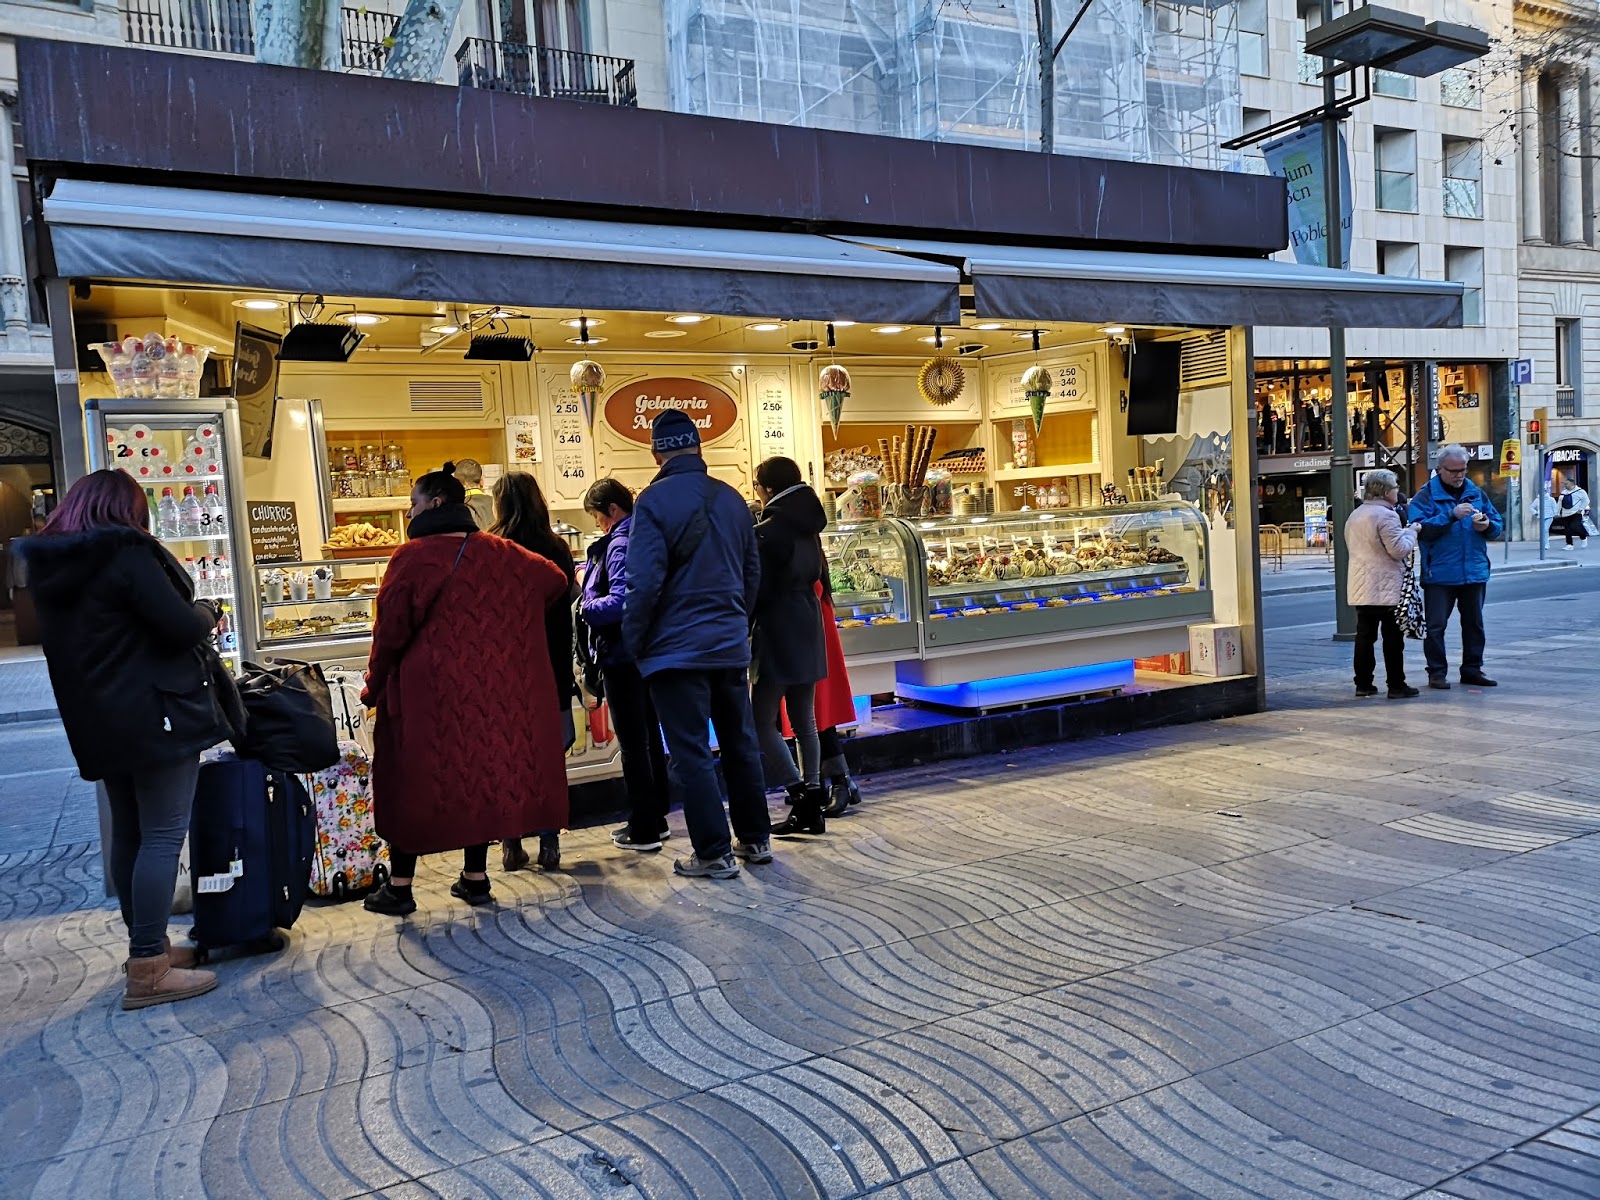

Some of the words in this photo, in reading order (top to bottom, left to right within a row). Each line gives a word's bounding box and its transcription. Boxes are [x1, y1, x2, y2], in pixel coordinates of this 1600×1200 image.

[1518, 362, 1530, 382] P
[635, 394, 709, 413] Gelateria
[1294, 459, 1331, 468] citadines
[252, 504, 293, 522] CHURROS
